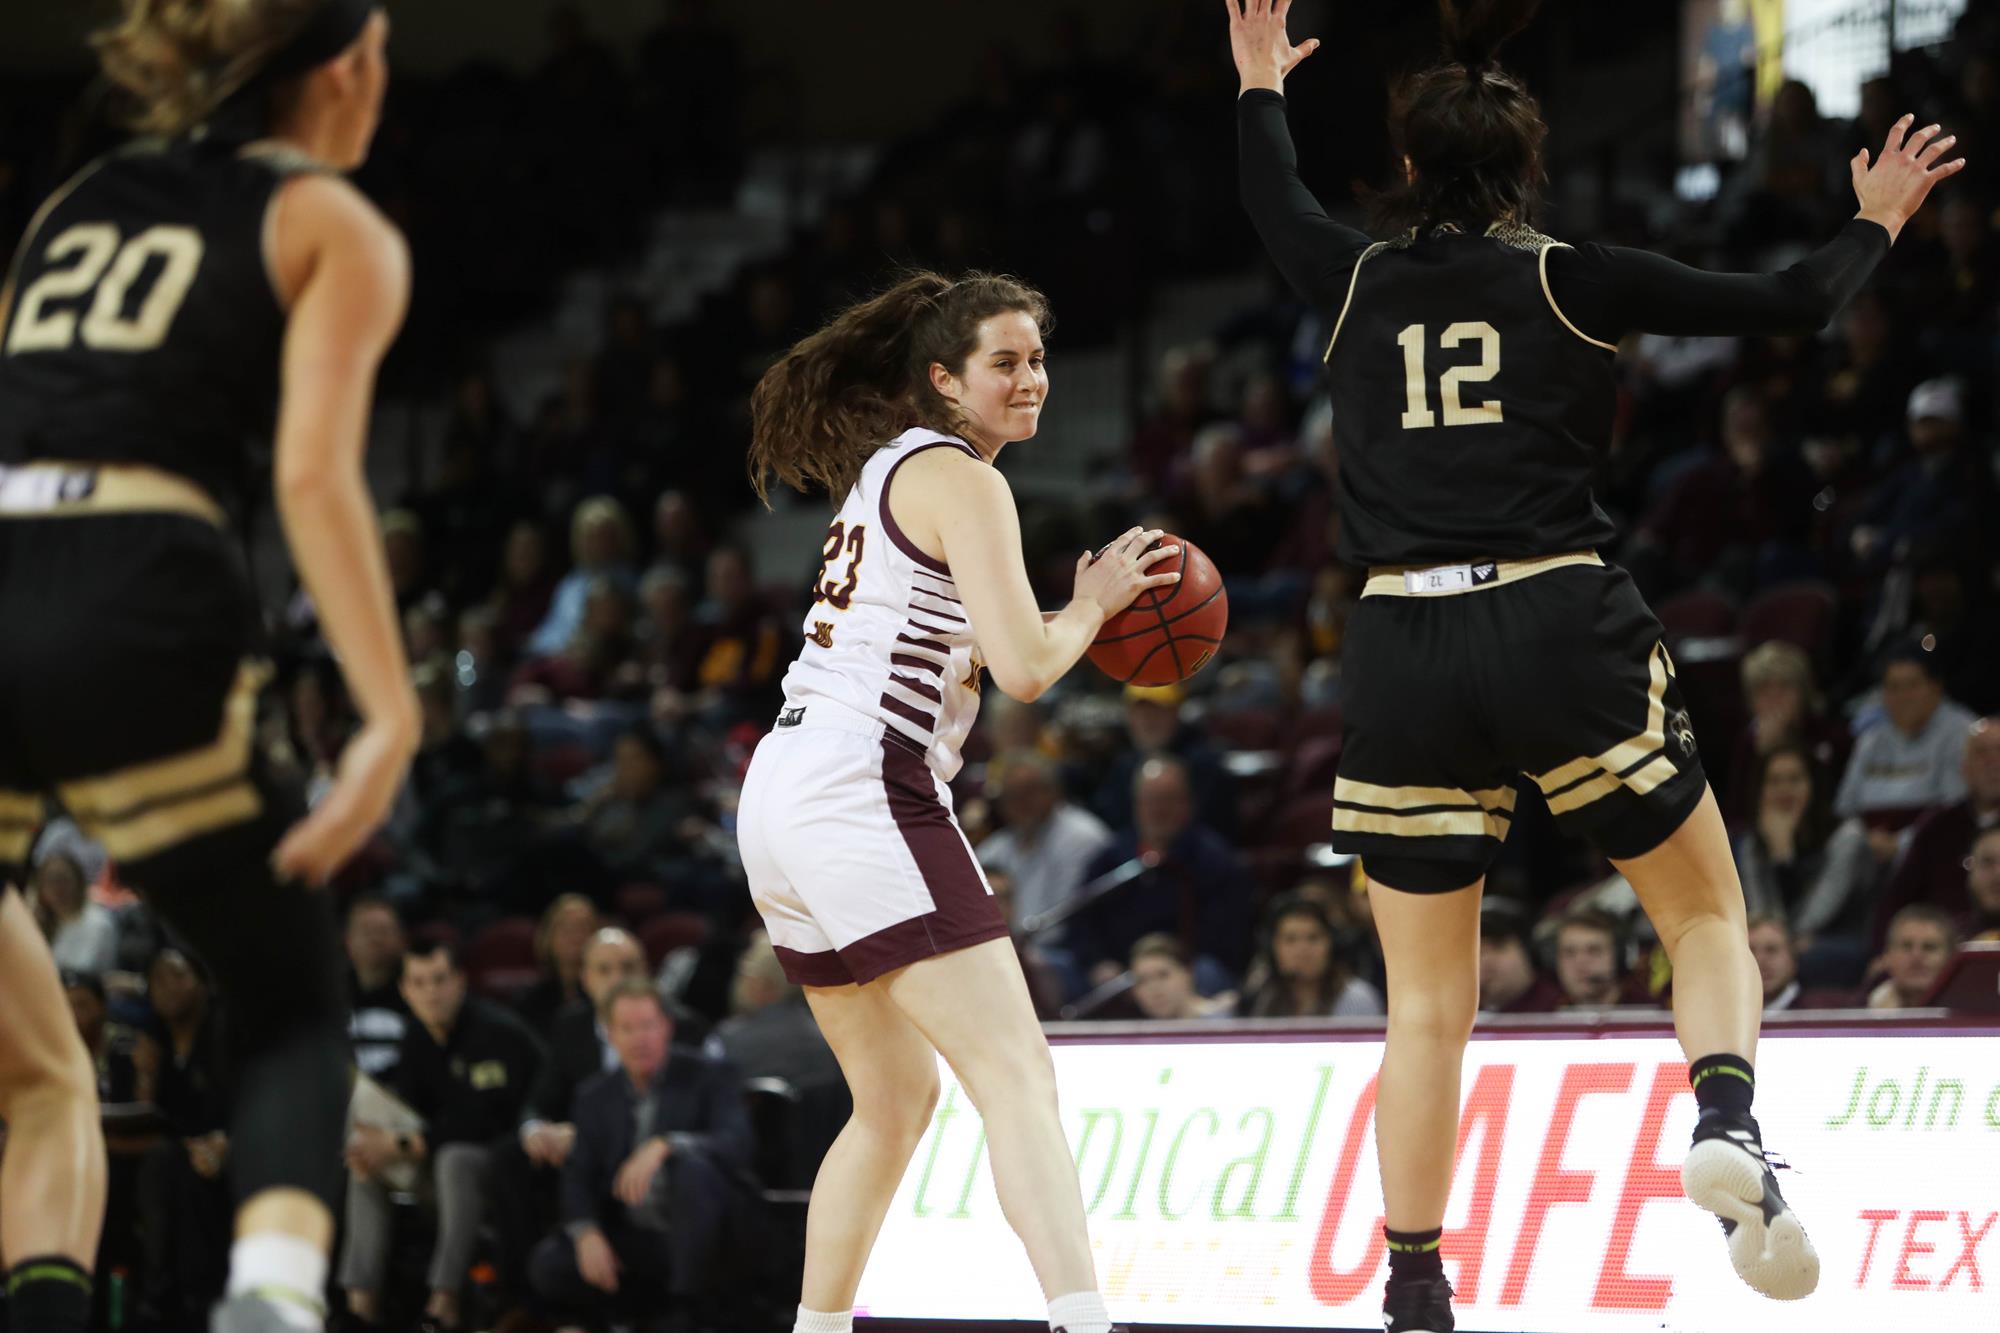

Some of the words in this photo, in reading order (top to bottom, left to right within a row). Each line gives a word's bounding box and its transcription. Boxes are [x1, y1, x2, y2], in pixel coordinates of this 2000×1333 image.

[5, 222, 204, 353] 20
[1396, 320, 1505, 430] 12
[1825, 1065, 1965, 1131] Join
